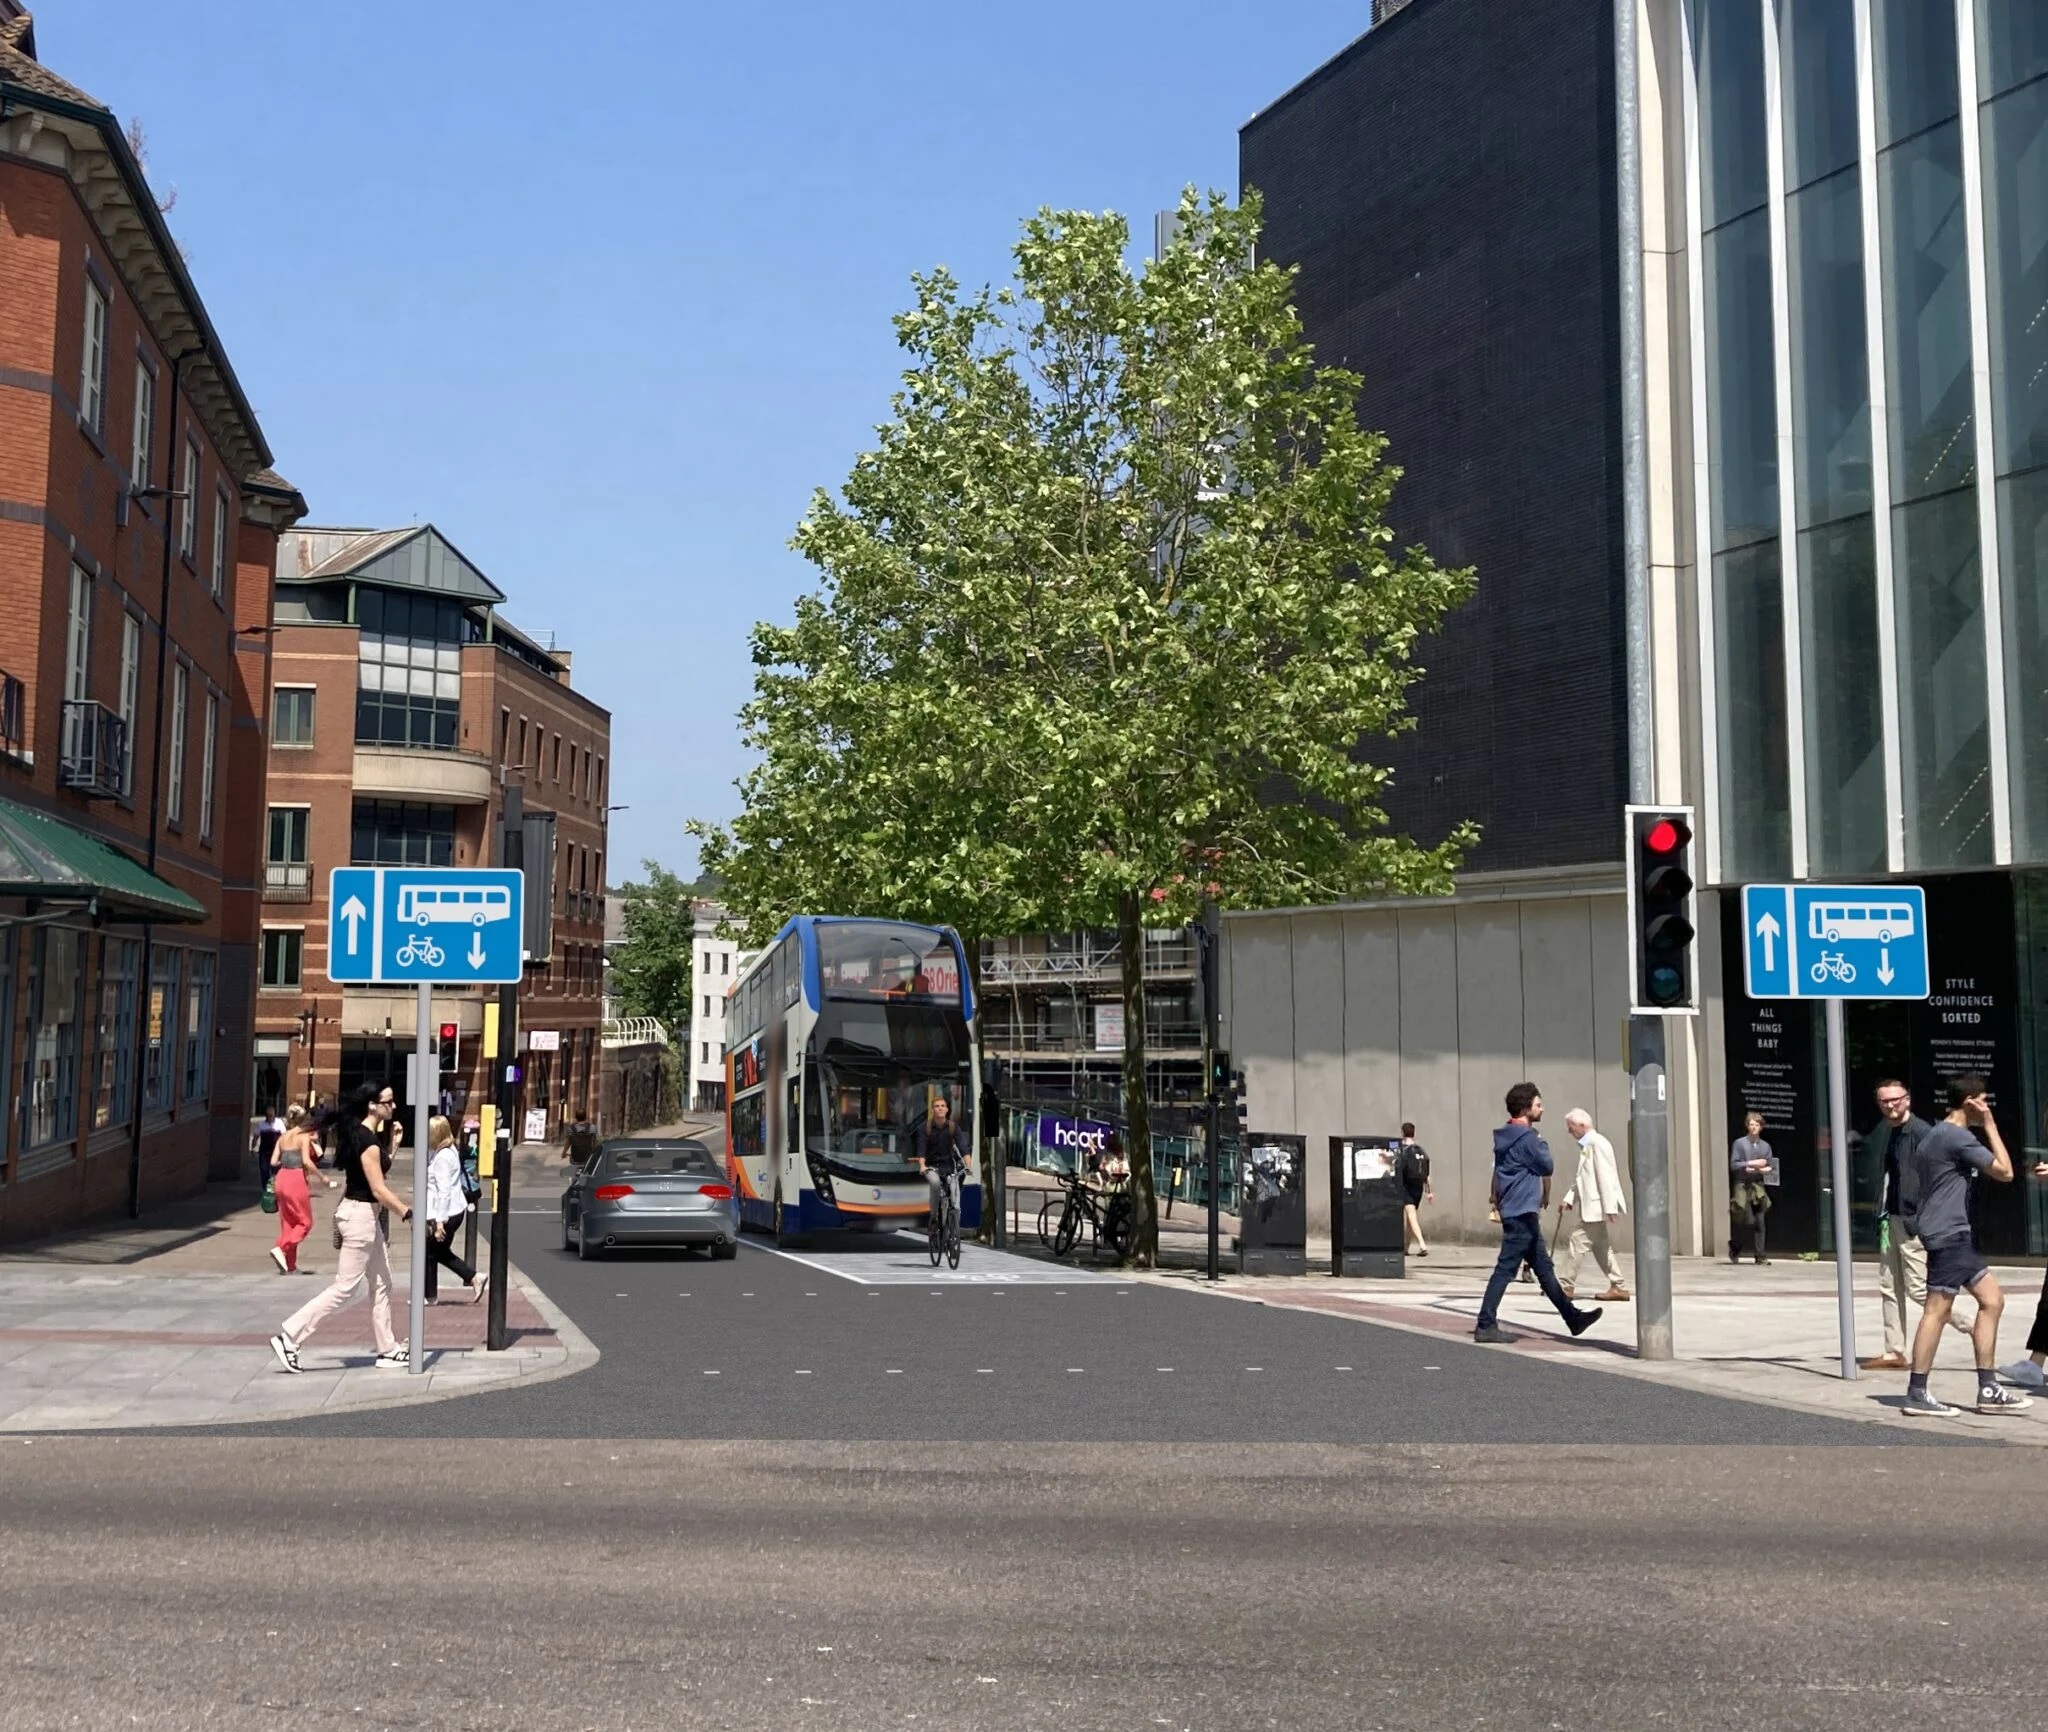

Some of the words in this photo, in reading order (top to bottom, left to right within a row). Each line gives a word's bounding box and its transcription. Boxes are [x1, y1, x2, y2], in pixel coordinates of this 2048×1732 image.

[1945, 978, 1975, 989] STYLE
[1928, 995, 1994, 1007] CONFIDENCE
[1759, 1007, 1775, 1018] ALL
[1942, 1012, 1981, 1024] SORTED
[1751, 1022, 1782, 1033] THINGS
[1757, 1038, 1779, 1049] BABY
